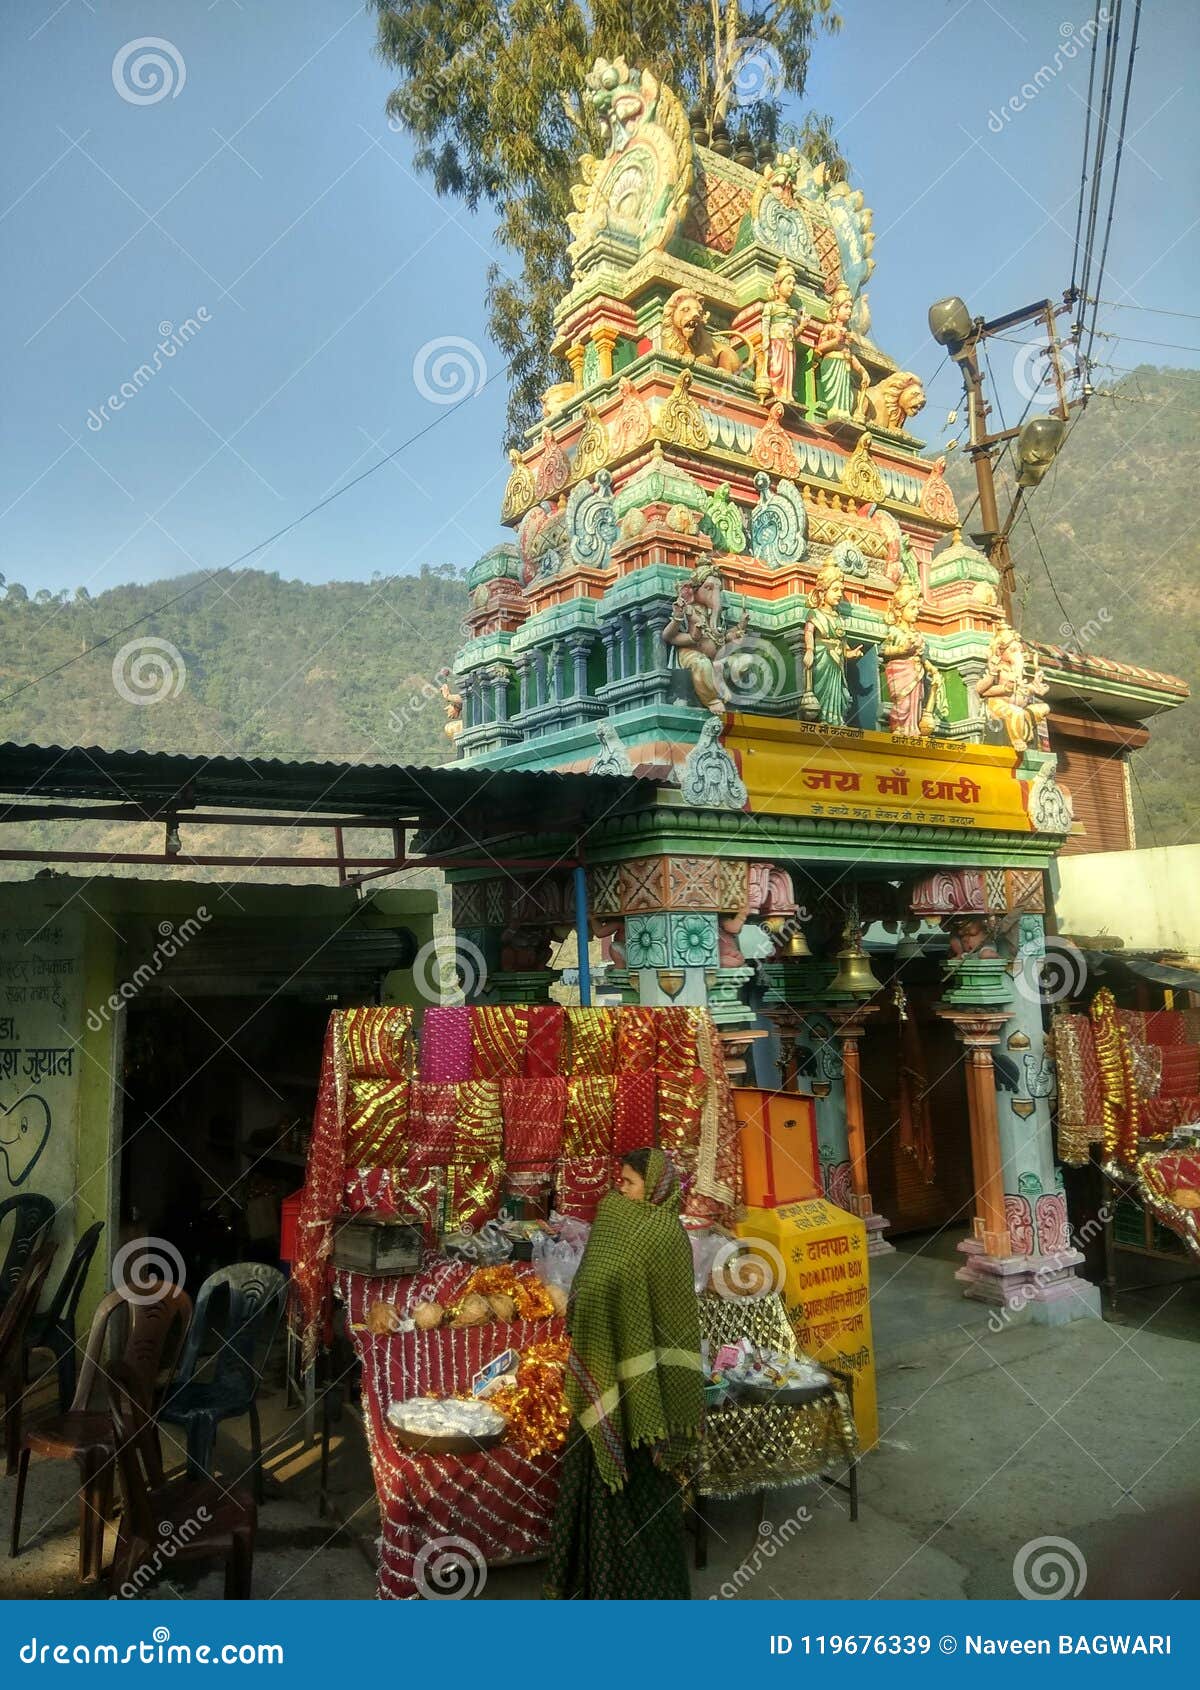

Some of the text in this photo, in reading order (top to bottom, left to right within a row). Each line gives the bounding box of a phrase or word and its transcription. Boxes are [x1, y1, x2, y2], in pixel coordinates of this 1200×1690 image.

[800, 722, 816, 734] जय
[801, 768, 860, 792] जय
[922, 776, 982, 804] धारी
[22, 1048, 75, 1085] जुयाल
[806, 1235, 849, 1261] दानपात्र
[800, 1260, 863, 1290] DONATION BOX
